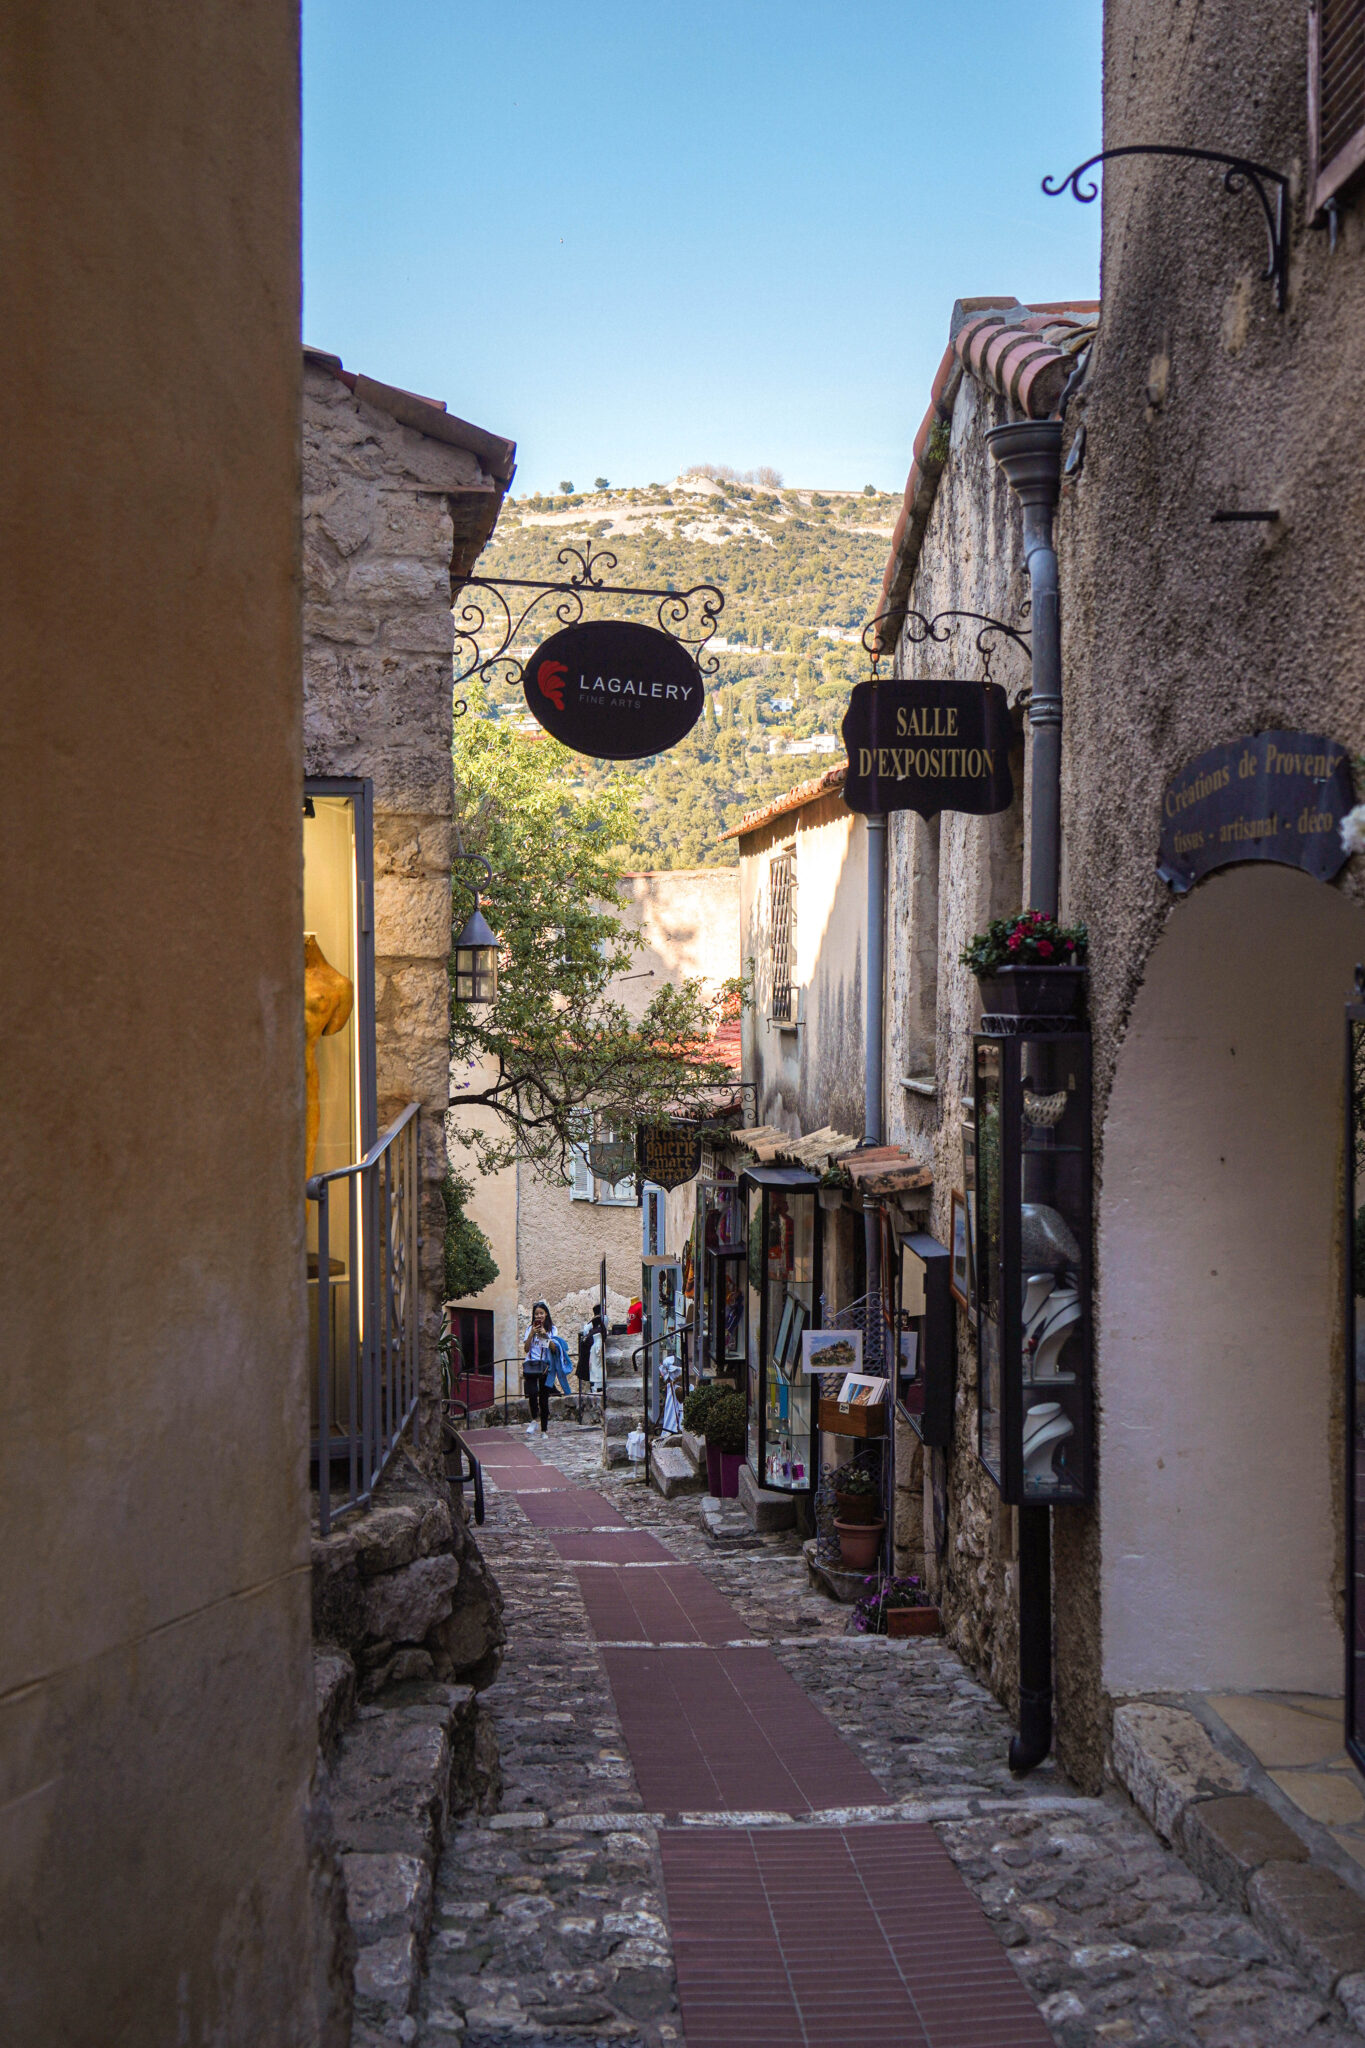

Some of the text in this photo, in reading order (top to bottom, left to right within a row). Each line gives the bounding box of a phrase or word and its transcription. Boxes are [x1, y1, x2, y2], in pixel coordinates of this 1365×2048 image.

[580, 675, 693, 701] LAGALERY
[580, 694, 641, 709] FINE ARTS
[897, 707, 958, 737] SALLE
[858, 748, 996, 778] D'EXPOSITION
[1165, 765, 1230, 818] Créations
[1238, 750, 1257, 780] de
[1220, 811, 1279, 842] artisanat
[1298, 806, 1333, 834] déco
